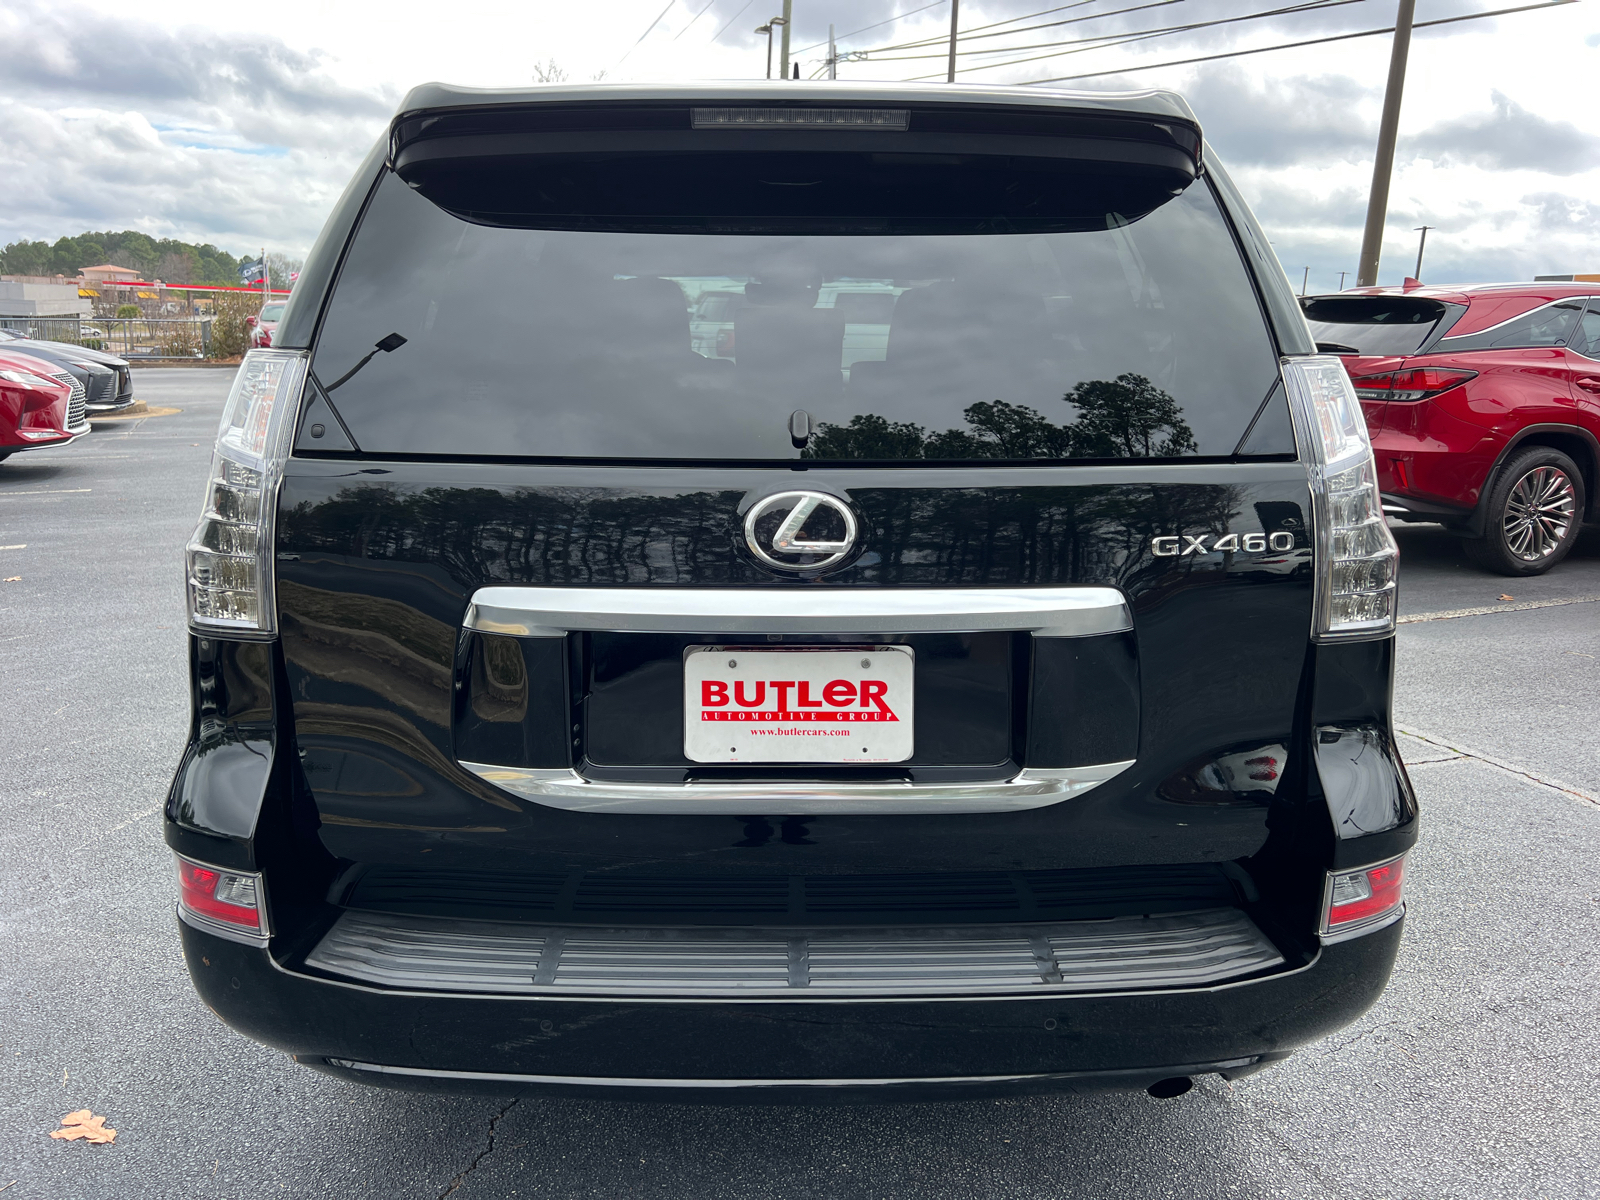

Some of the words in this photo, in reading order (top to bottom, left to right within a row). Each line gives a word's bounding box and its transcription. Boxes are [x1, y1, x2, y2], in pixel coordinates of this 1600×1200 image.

[702, 712, 817, 721] AUTOMOTIVE
[837, 712, 893, 721] GROUP
[750, 727, 851, 737] www.butlercars.com
